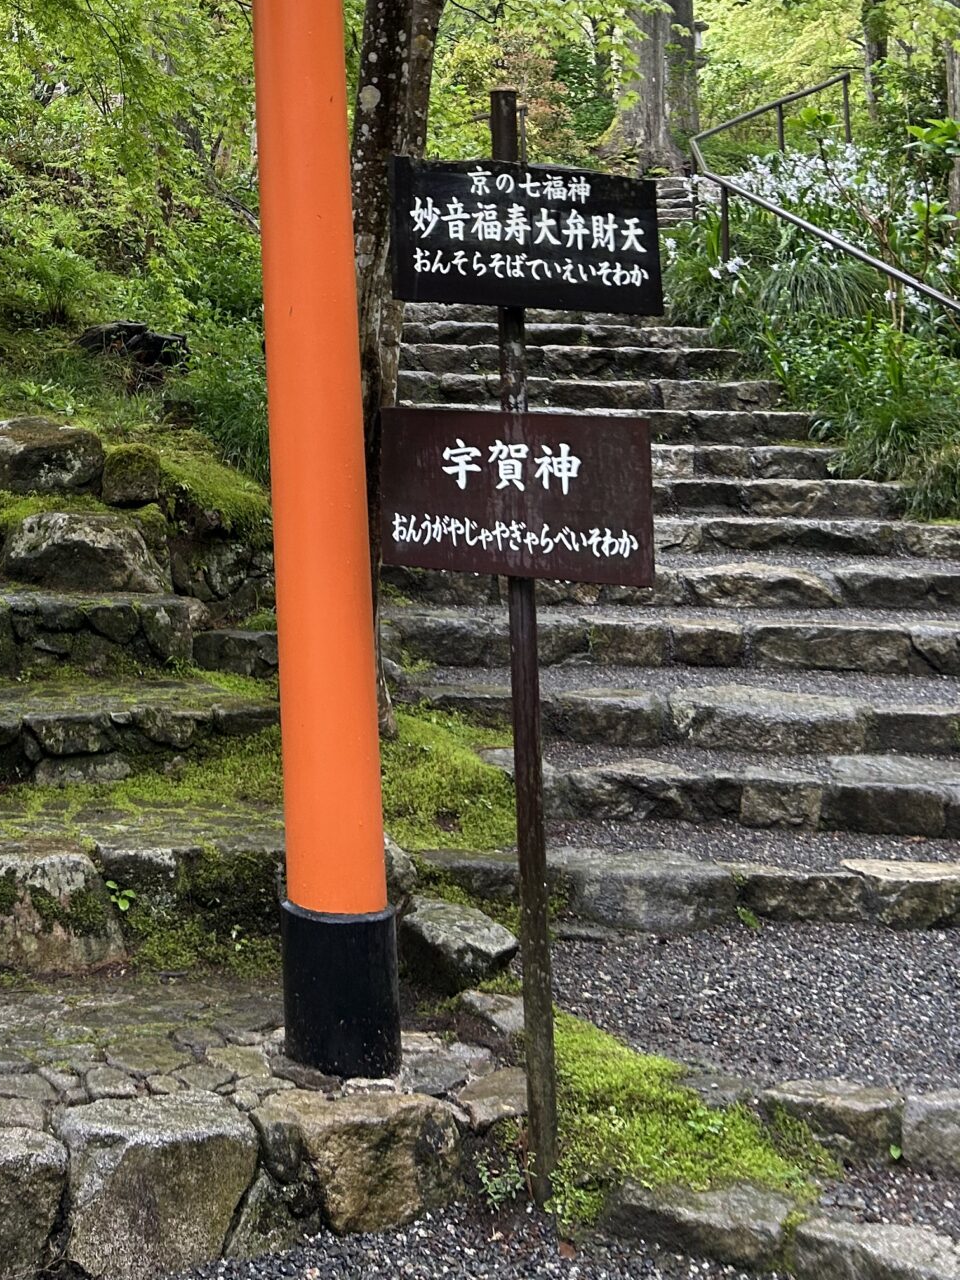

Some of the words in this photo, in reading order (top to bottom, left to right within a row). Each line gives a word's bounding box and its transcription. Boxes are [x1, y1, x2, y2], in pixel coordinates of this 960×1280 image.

[467, 166, 591, 204] 京の七福神
[409, 196, 647, 253] 妙音福寿大弁財天
[412, 247, 650, 287] おんそらそばていえいそわか
[441, 438, 582, 495] 宇賀神
